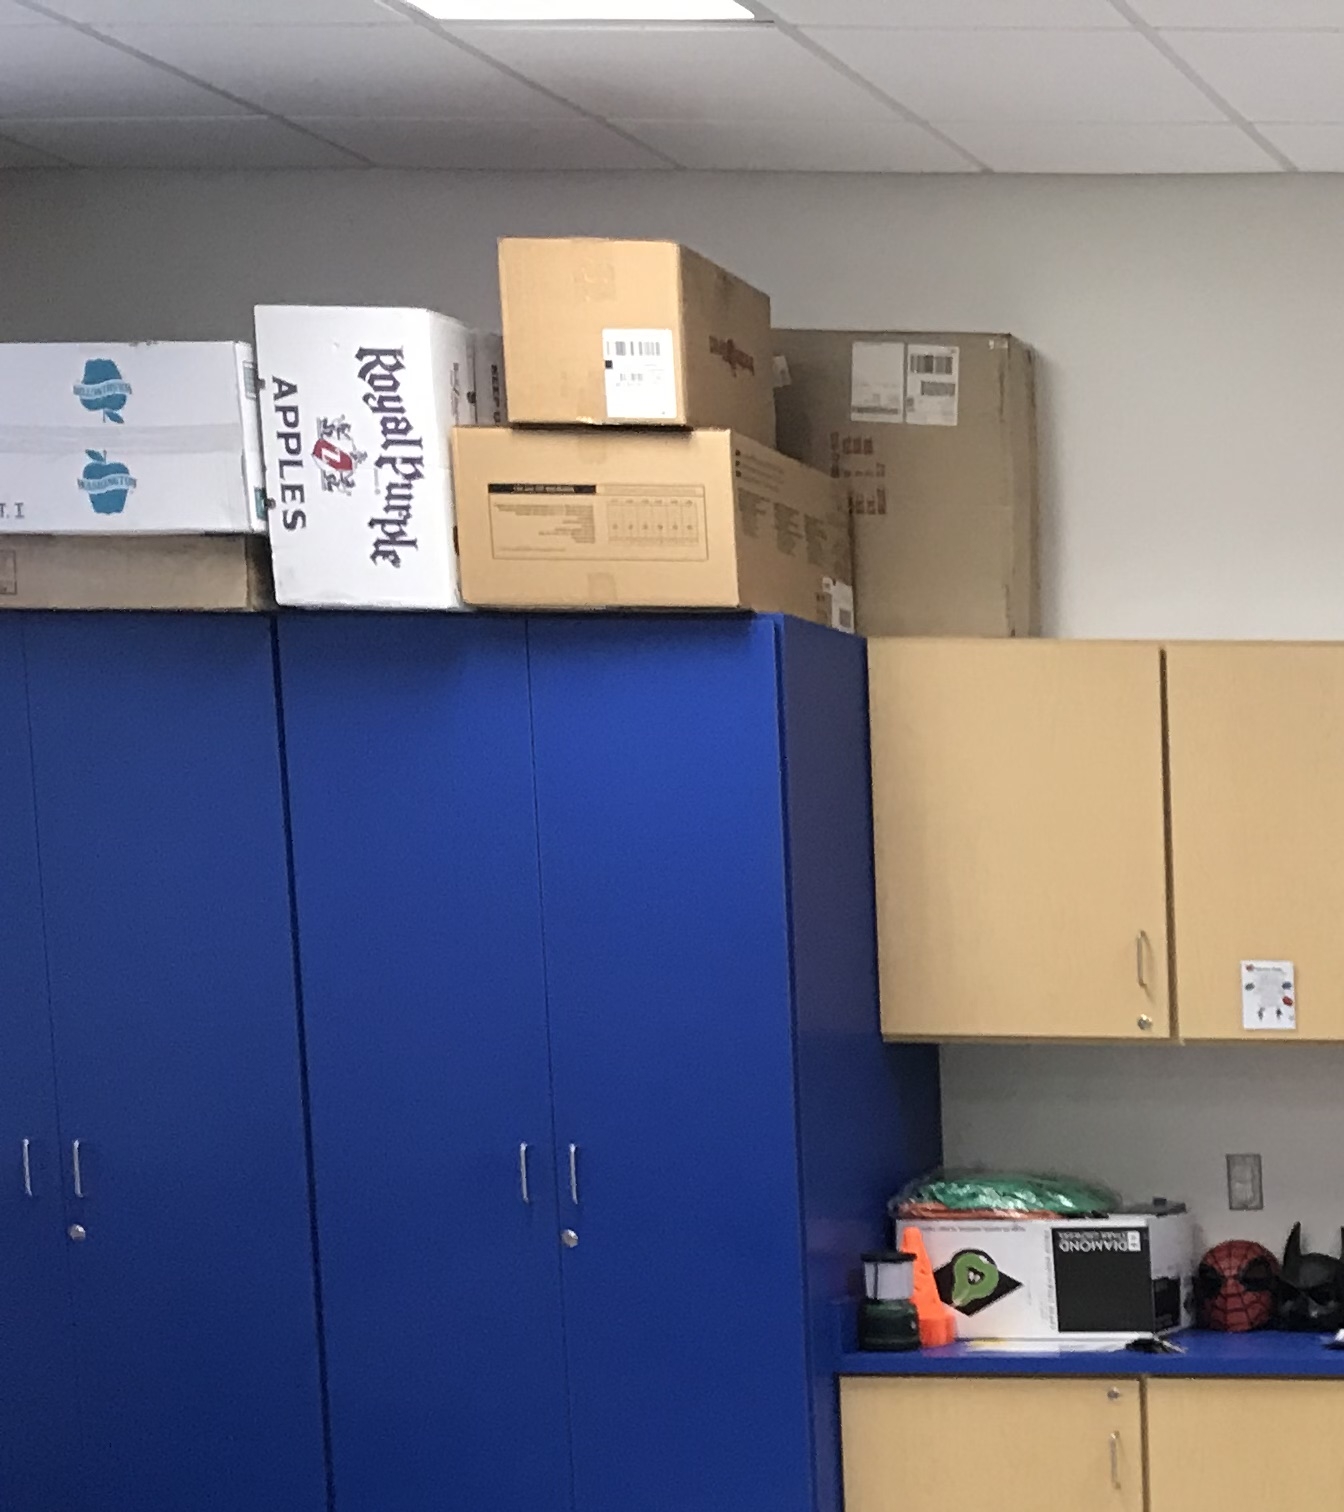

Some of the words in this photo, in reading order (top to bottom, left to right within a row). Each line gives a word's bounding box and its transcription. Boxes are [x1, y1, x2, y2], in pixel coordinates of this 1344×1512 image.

[354, 346, 424, 450] Royal
[271, 375, 307, 532] APPLES
[367, 454, 426, 569] Purple
[1058, 1240, 1128, 1252] DIAMOND
